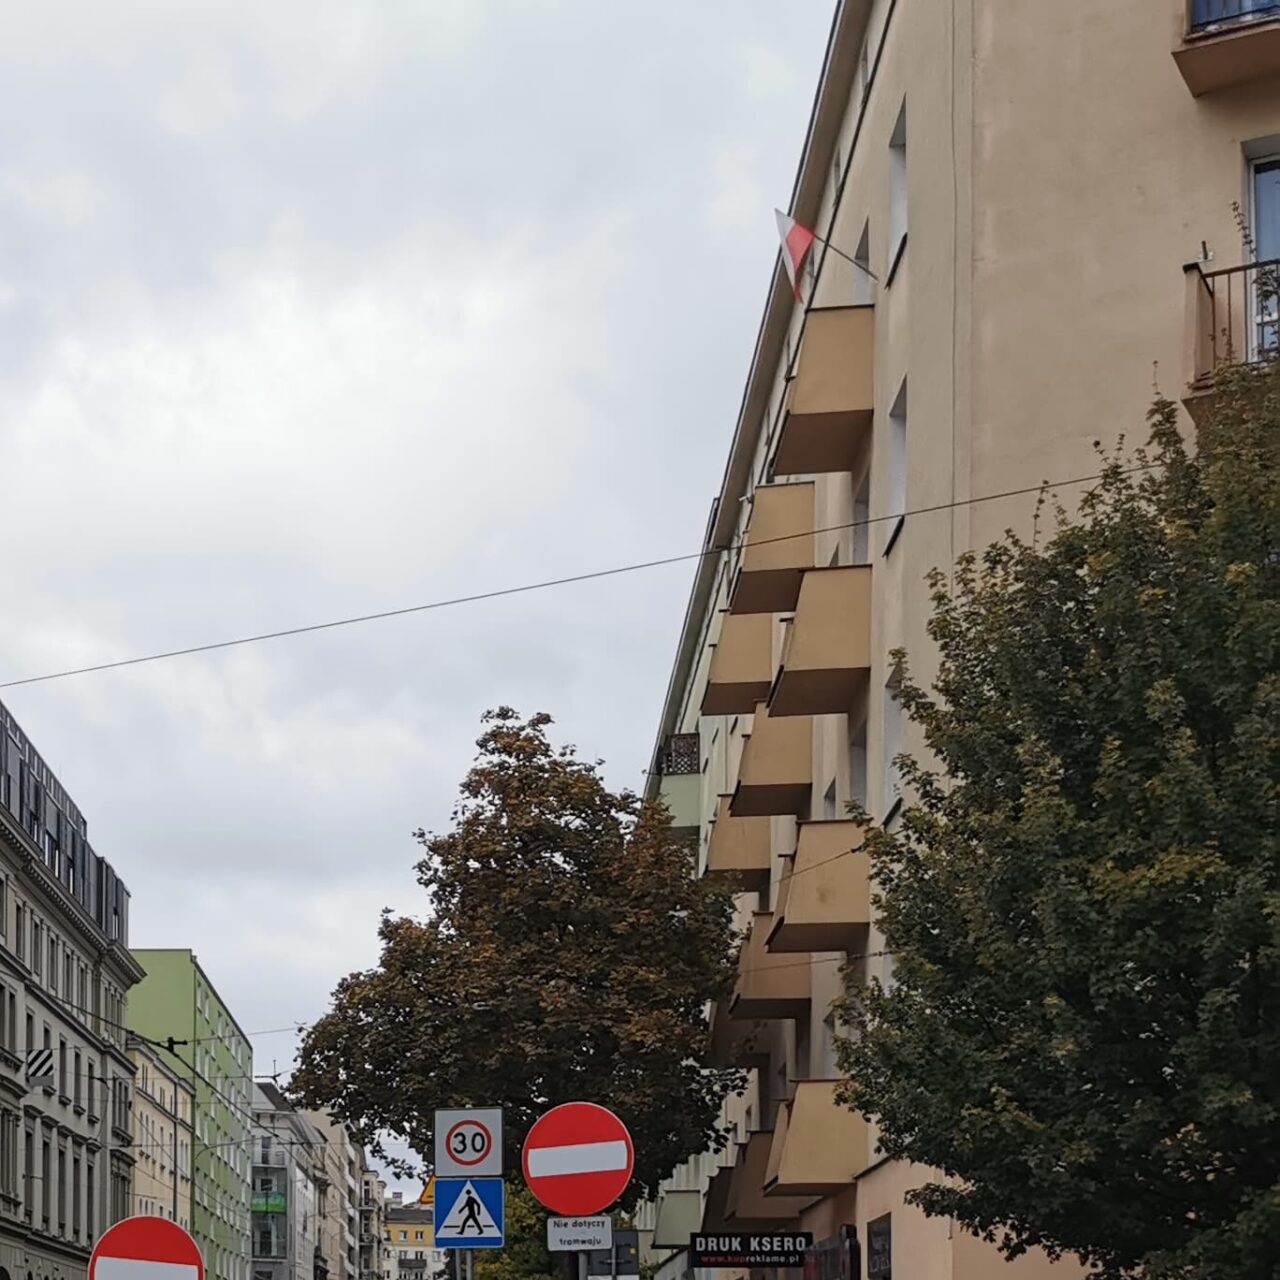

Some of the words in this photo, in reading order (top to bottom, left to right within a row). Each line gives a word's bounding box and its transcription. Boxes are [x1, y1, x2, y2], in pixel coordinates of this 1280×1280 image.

[453, 1132, 486, 1154] 30
[553, 1220, 569, 1229] Nie
[571, 1219, 606, 1230] dotyczy
[559, 1235, 602, 1247] tramwaju
[695, 1237, 741, 1252] DRUK
[749, 1237, 806, 1252] KSERO
